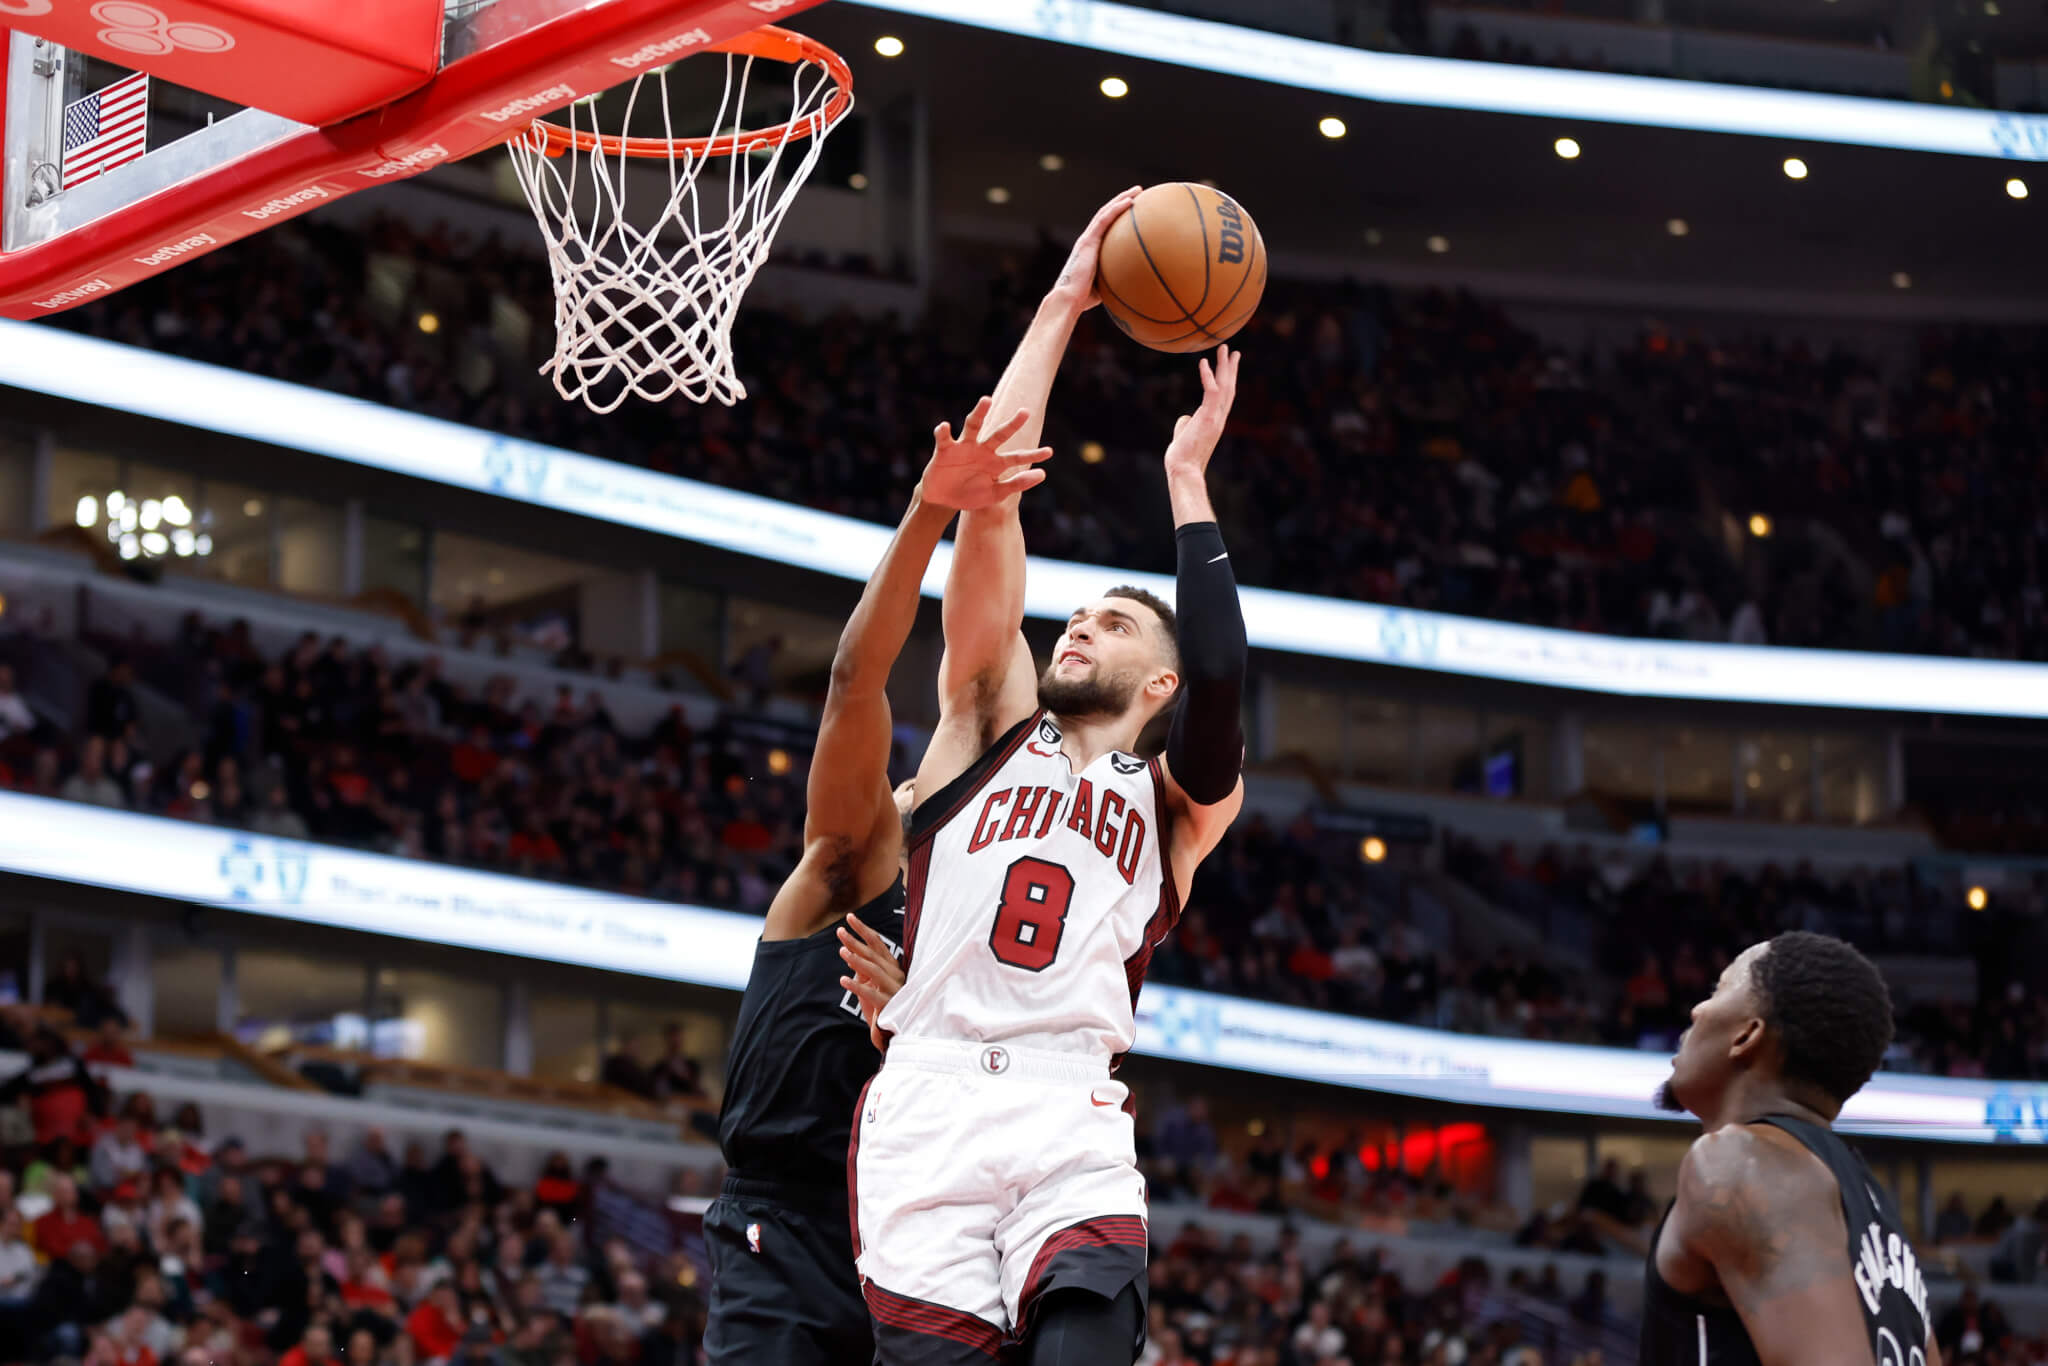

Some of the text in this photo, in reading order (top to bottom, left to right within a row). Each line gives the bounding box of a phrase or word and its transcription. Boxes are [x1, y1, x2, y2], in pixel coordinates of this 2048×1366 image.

[610, 27, 712, 69] betway
[480, 82, 578, 122] betway
[356, 142, 449, 178] betway
[241, 185, 330, 220] betway
[133, 232, 217, 267] betway
[1217, 198, 1244, 264] Wils
[31, 278, 113, 309] betway
[967, 777, 1146, 886] CHIAGO
[988, 855, 1076, 973] 8
